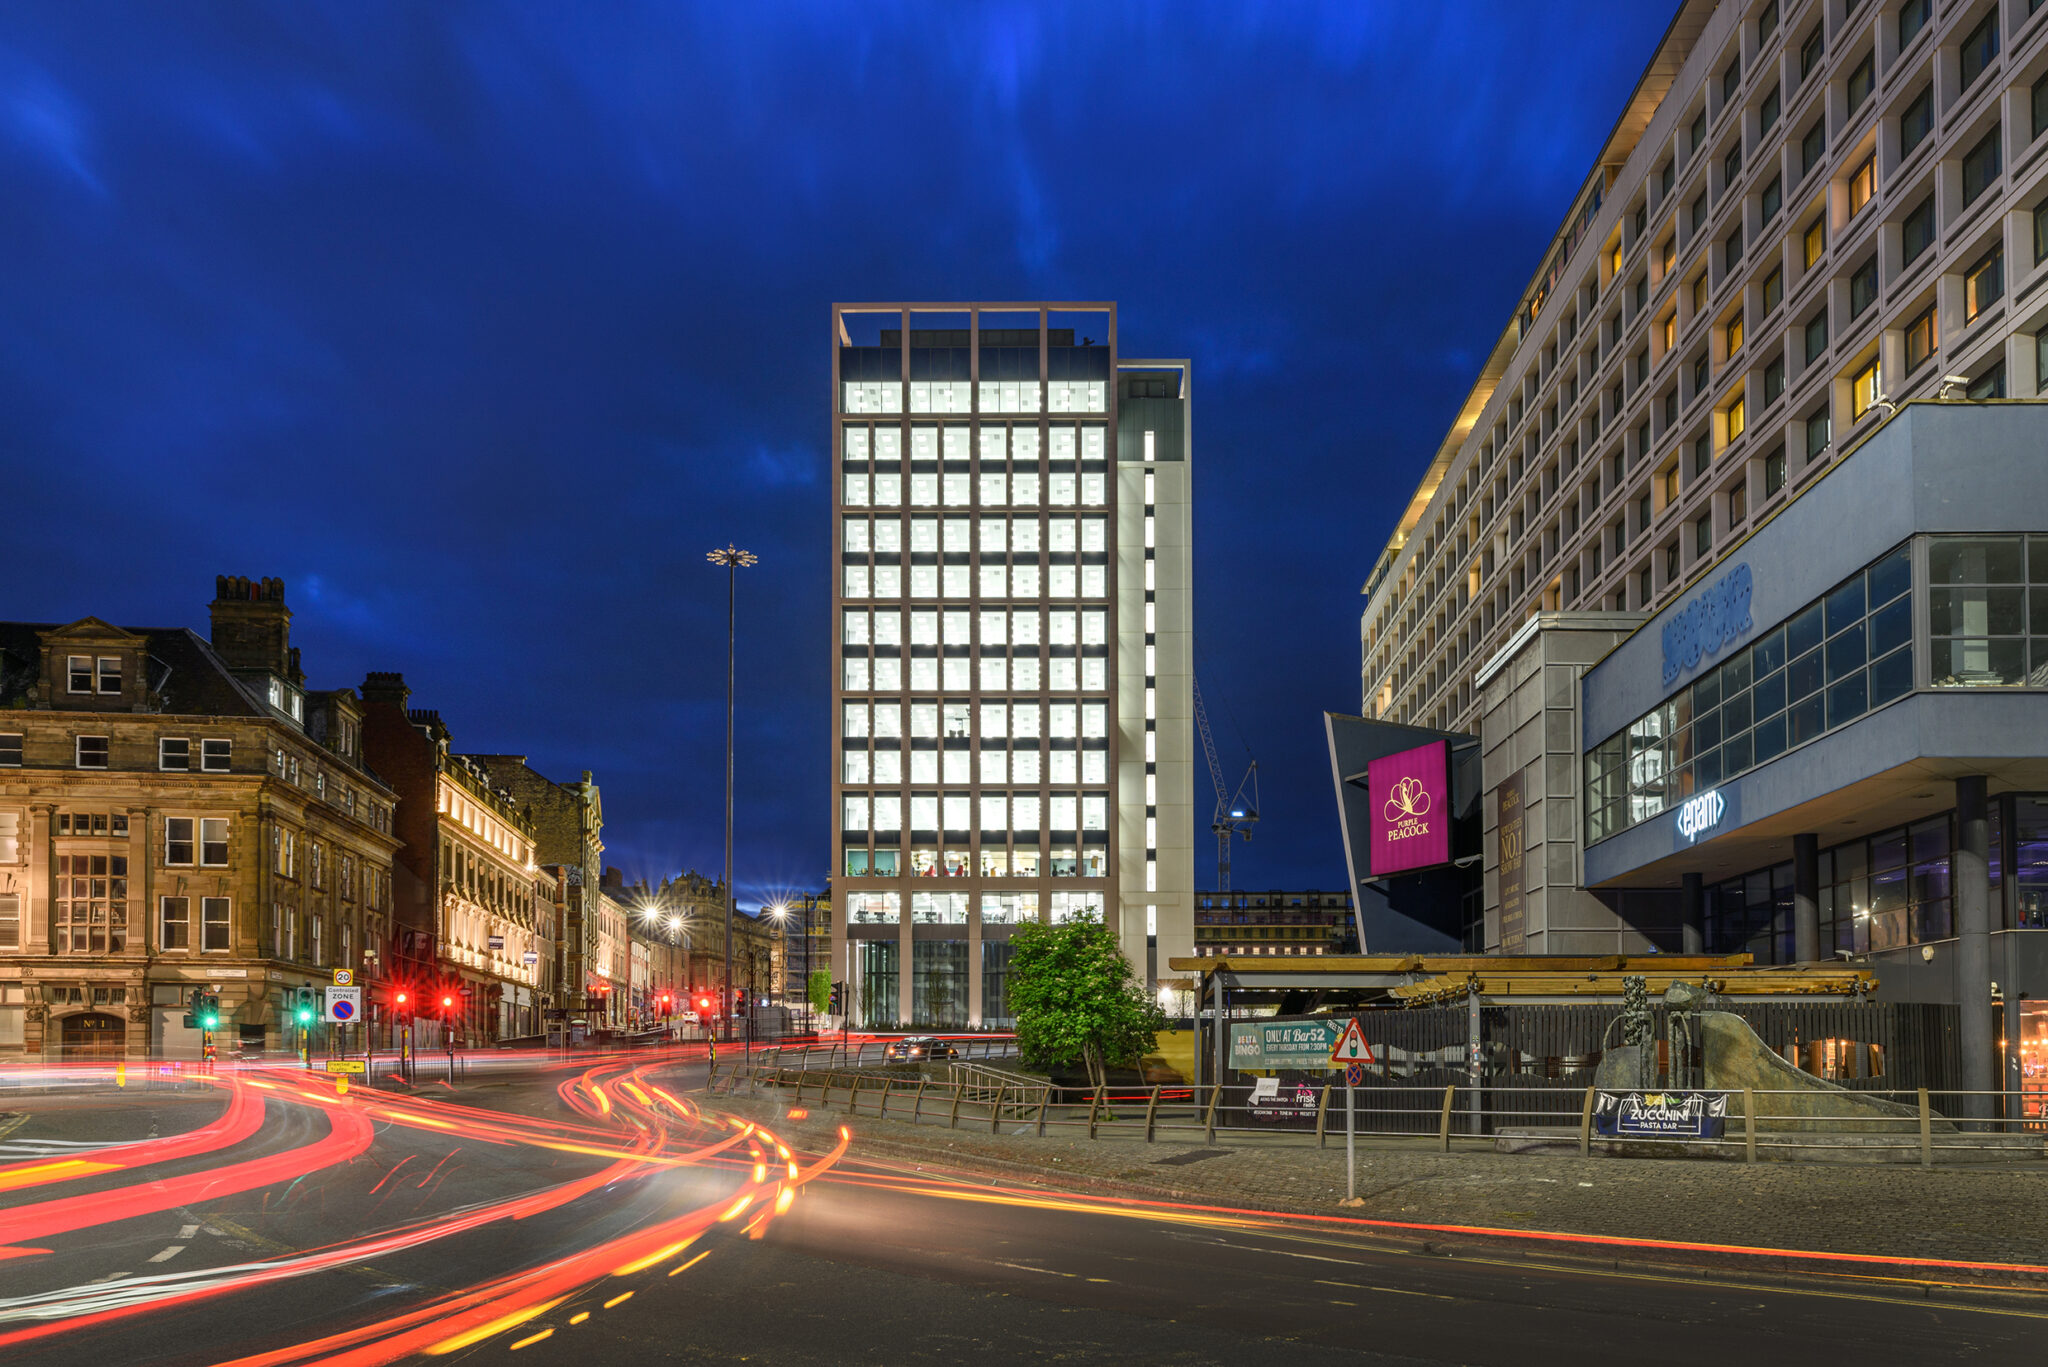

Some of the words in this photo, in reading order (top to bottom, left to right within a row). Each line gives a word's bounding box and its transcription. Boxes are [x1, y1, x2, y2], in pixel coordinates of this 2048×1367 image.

[1397, 818, 1418, 828] PURPLE
[1388, 822, 1429, 841] PEACOCK
[1501, 829, 1522, 864] NO.1
[337, 973, 349, 981] 20
[1326, 1019, 1337, 1031] FREE
[1265, 1029, 1282, 1043] ONLY
[1283, 1029, 1292, 1042] AT
[1234, 1044, 1261, 1056] BINGO
[1266, 1043, 1279, 1052] EVERY
[1298, 1042, 1310, 1051] FROM
[1296, 1093, 1316, 1103] frisk
[1630, 1109, 1689, 1121] ZUCCHINI
